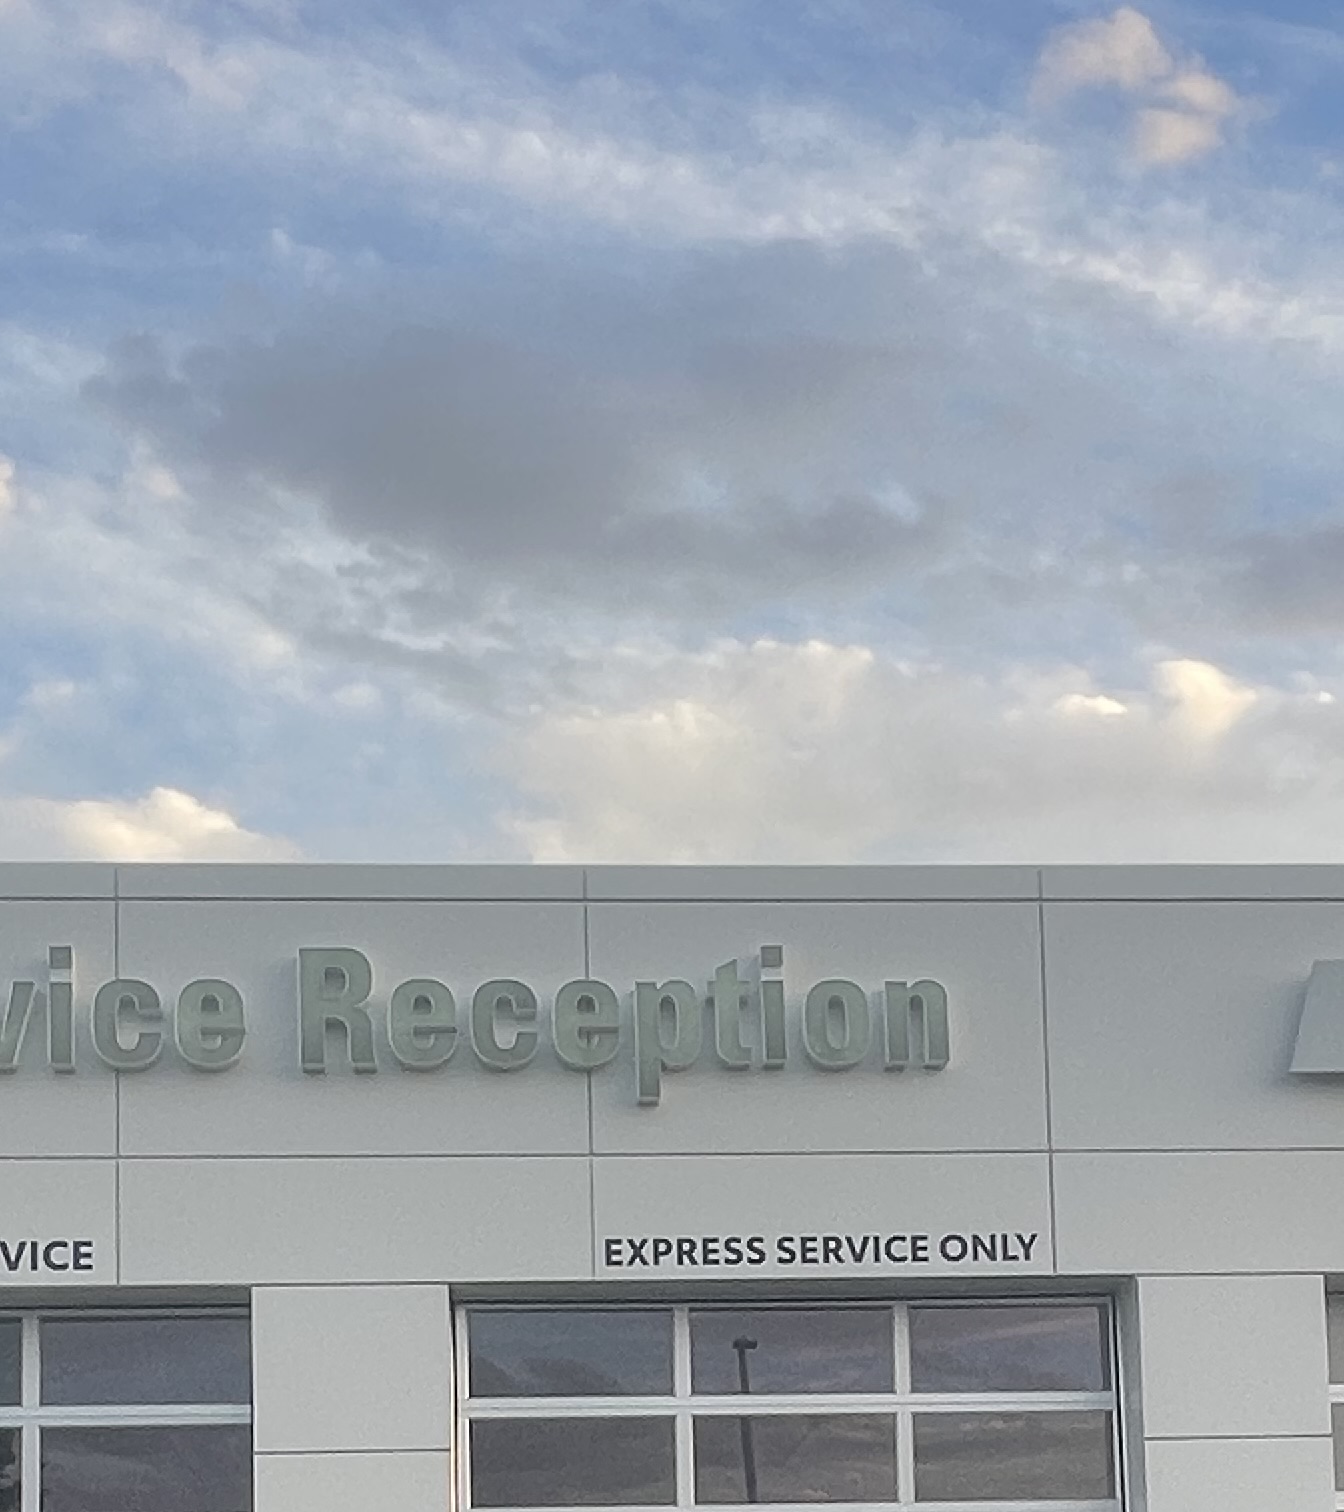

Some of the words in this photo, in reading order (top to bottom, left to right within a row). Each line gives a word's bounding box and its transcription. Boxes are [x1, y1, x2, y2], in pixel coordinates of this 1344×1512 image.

[296, 944, 951, 1106] Reception
[604, 1235, 767, 1267] EXPRESS
[775, 1234, 930, 1264] SERVICE
[939, 1232, 1038, 1262] ONLY
